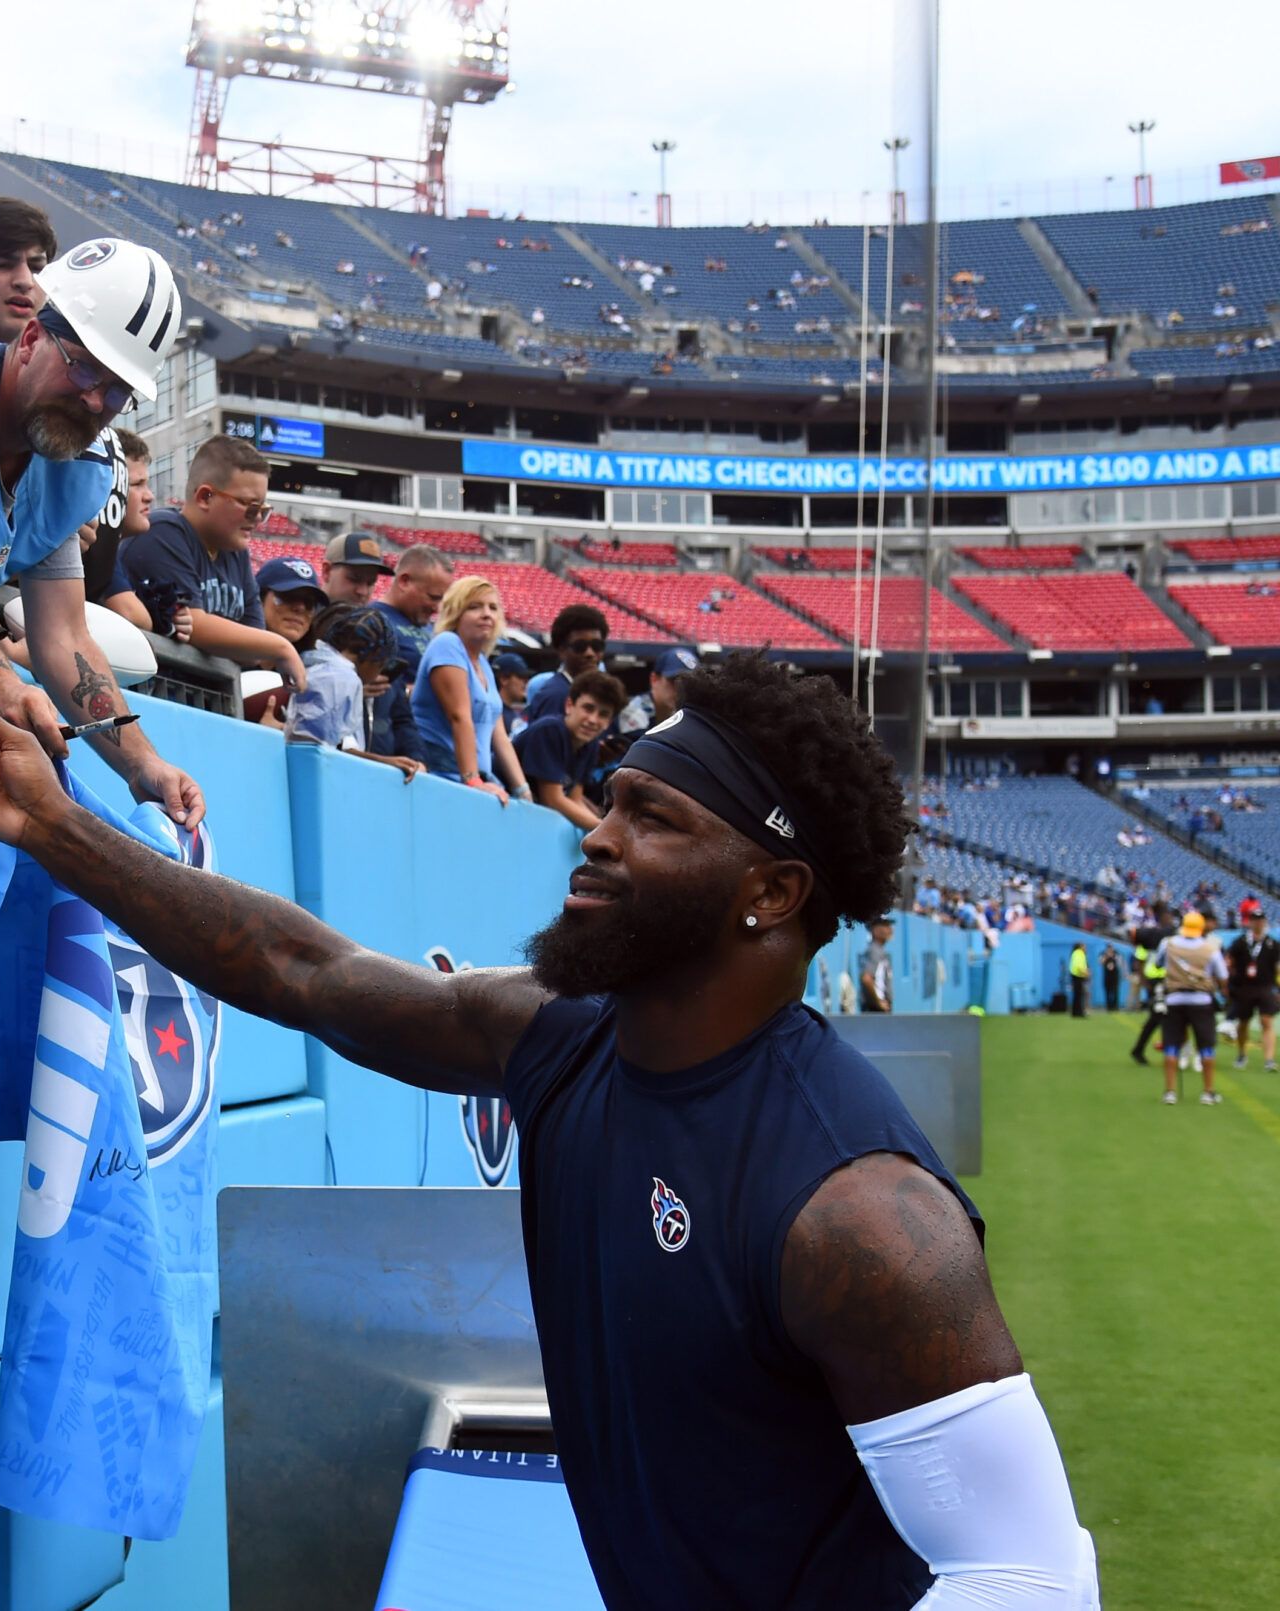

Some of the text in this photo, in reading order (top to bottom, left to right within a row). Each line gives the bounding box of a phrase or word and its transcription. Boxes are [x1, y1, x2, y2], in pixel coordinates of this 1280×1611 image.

[520, 449, 593, 478] OPEN
[595, 456, 615, 480] A
[616, 456, 711, 483] TITANS
[715, 458, 856, 487] CHECKING
[859, 463, 995, 488] ACCOUNT
[1000, 460, 1076, 485] WITH
[1080, 455, 1149, 485] $100
[1154, 453, 1219, 480] AND
[1221, 450, 1245, 477] A
